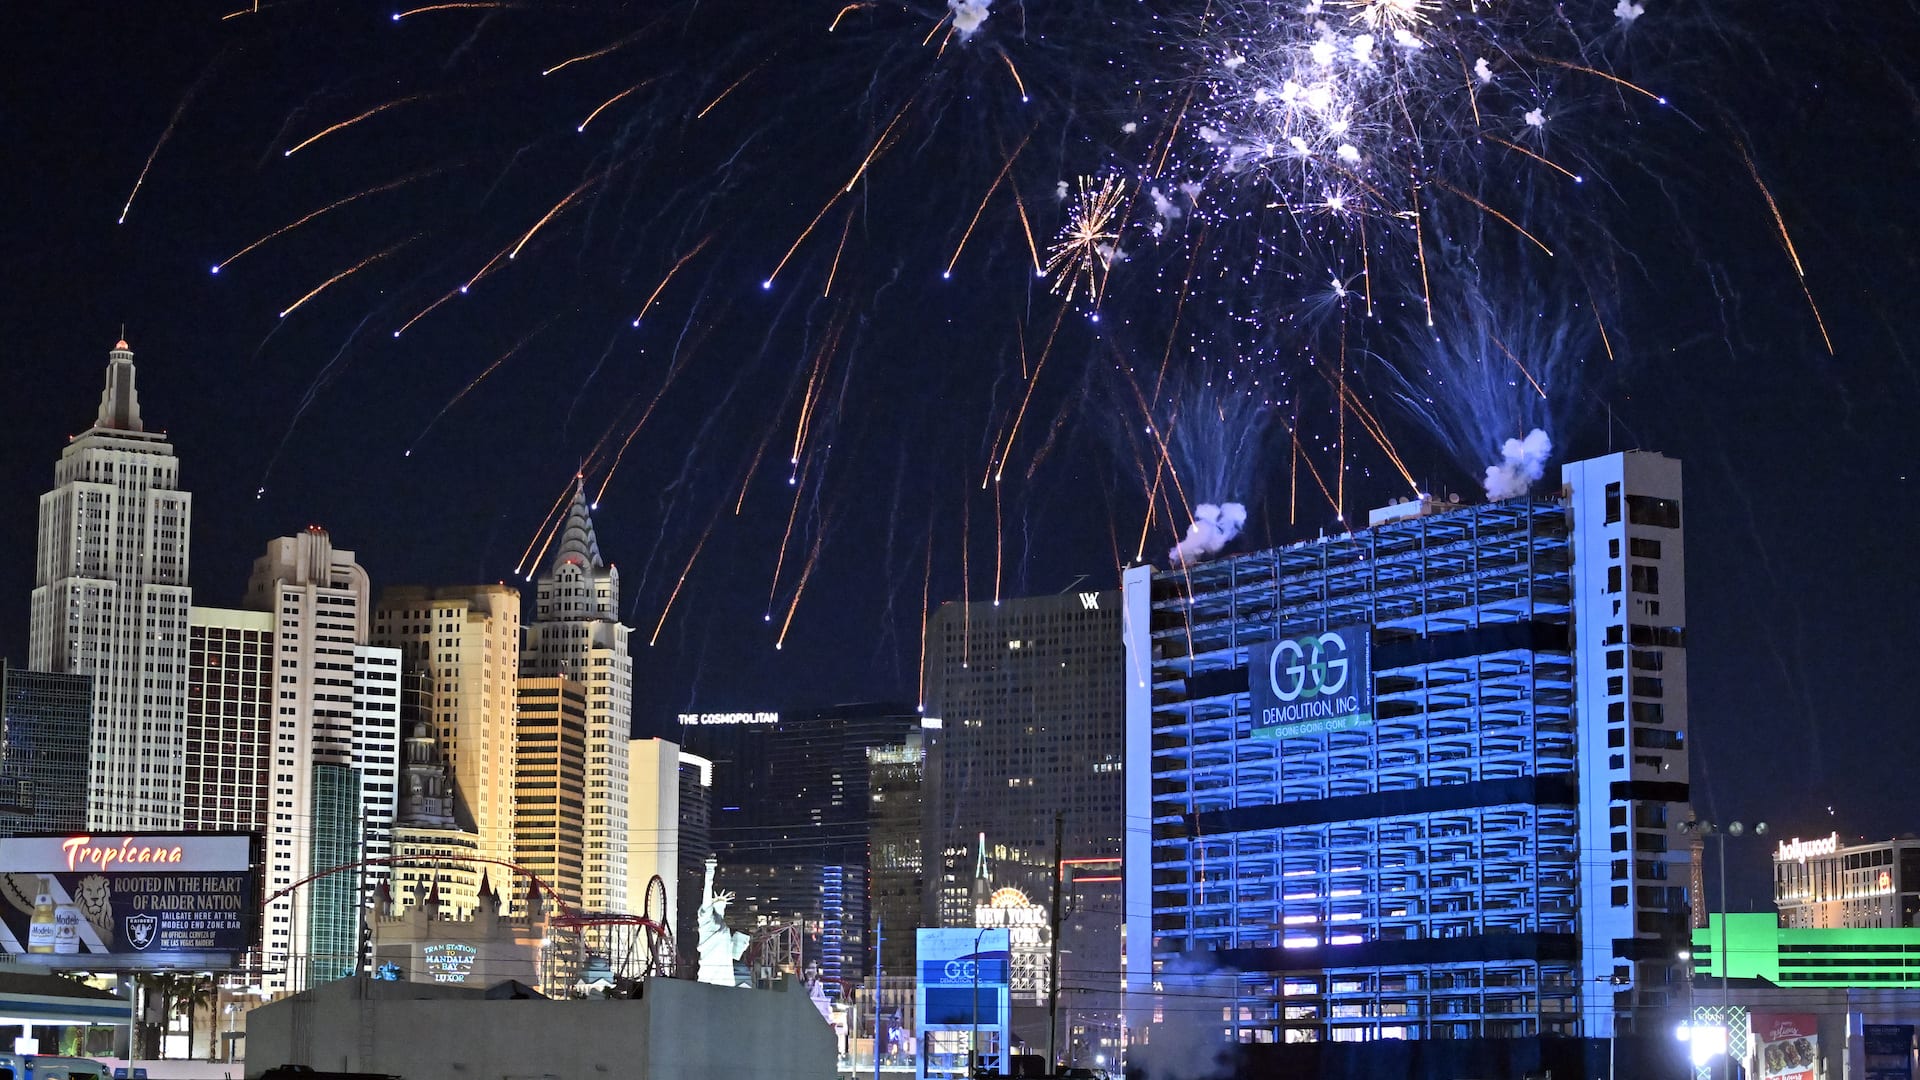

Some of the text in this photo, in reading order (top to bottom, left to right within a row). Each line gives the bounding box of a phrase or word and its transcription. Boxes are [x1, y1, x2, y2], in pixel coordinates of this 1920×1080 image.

[1262, 695, 1360, 725] DEMOLITION, INC.
[678, 712, 778, 725] THE COSMOPOLITAN
[62, 836, 182, 872] Tropicana
[1779, 831, 1836, 865] hollywood
[114, 877, 243, 893] ROOTED IN THE HEART
[133, 895, 242, 910] OF RAIDER NATION
[56, 914, 79, 925] Modelo
[162, 912, 237, 920] TAILGATE HERE AT THE
[976, 908, 1046, 924] NEW YORK
[161, 921, 241, 929] MODELO END ZONE BAR
[168, 931, 188, 939] OFFICIAL
[160, 939, 169, 947] THE
[170, 939, 179, 947] LAS
[180, 939, 194, 947] VEGAS
[424, 944, 477, 954] TRAM STATION
[435, 974, 464, 982] LUXOR
